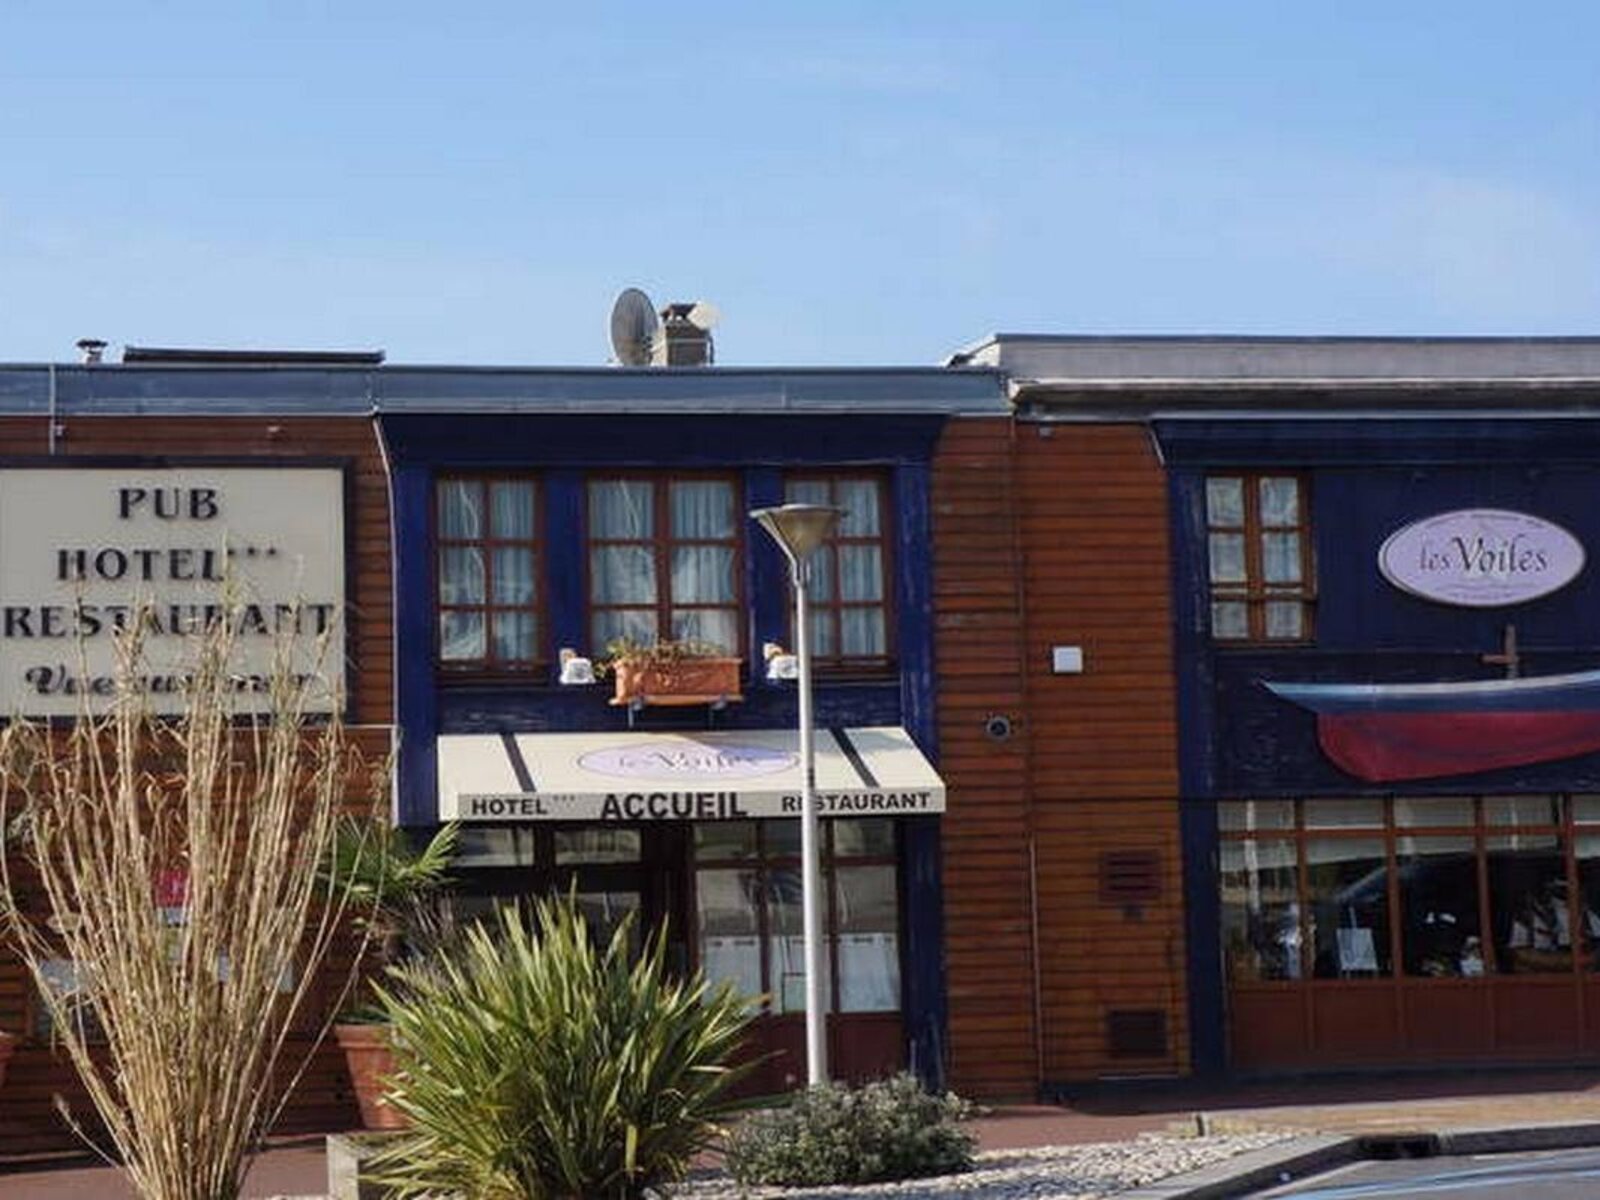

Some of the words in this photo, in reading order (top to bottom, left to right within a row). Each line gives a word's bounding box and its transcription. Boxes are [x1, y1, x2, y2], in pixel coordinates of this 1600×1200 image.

[118, 487, 219, 520] PUB
[56, 548, 225, 581] HOTEL
[1451, 533, 1548, 573] Voiles
[471, 798, 548, 816] HOTEL
[601, 792, 749, 820] ACCUEIL
